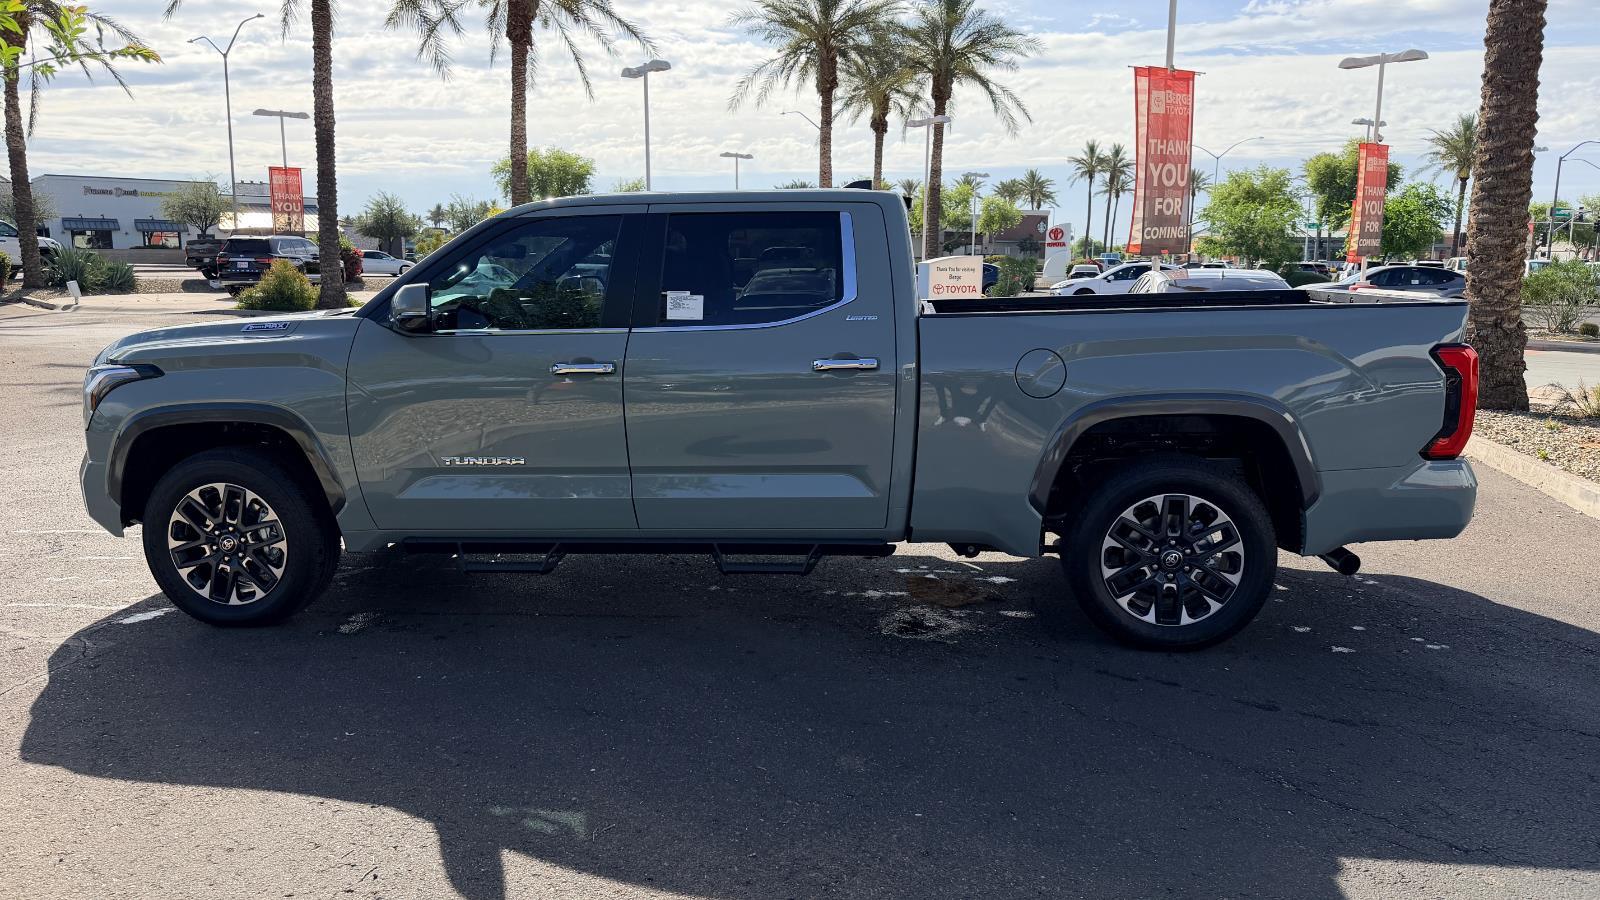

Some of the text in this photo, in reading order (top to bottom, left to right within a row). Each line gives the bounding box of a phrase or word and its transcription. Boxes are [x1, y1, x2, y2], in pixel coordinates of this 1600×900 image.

[1148, 138, 1190, 155] THANK
[1149, 163, 1189, 187] YOU
[1364, 186, 1385, 196] THANK
[275, 202, 301, 212] YOU
[1154, 198, 1182, 216] FOR
[1364, 200, 1384, 215] YOU
[1364, 221, 1380, 232] FOR
[1143, 226, 1187, 240] COMING!
[945, 285, 977, 294] TOYOTA
[440, 456, 525, 466] TUNDRA
